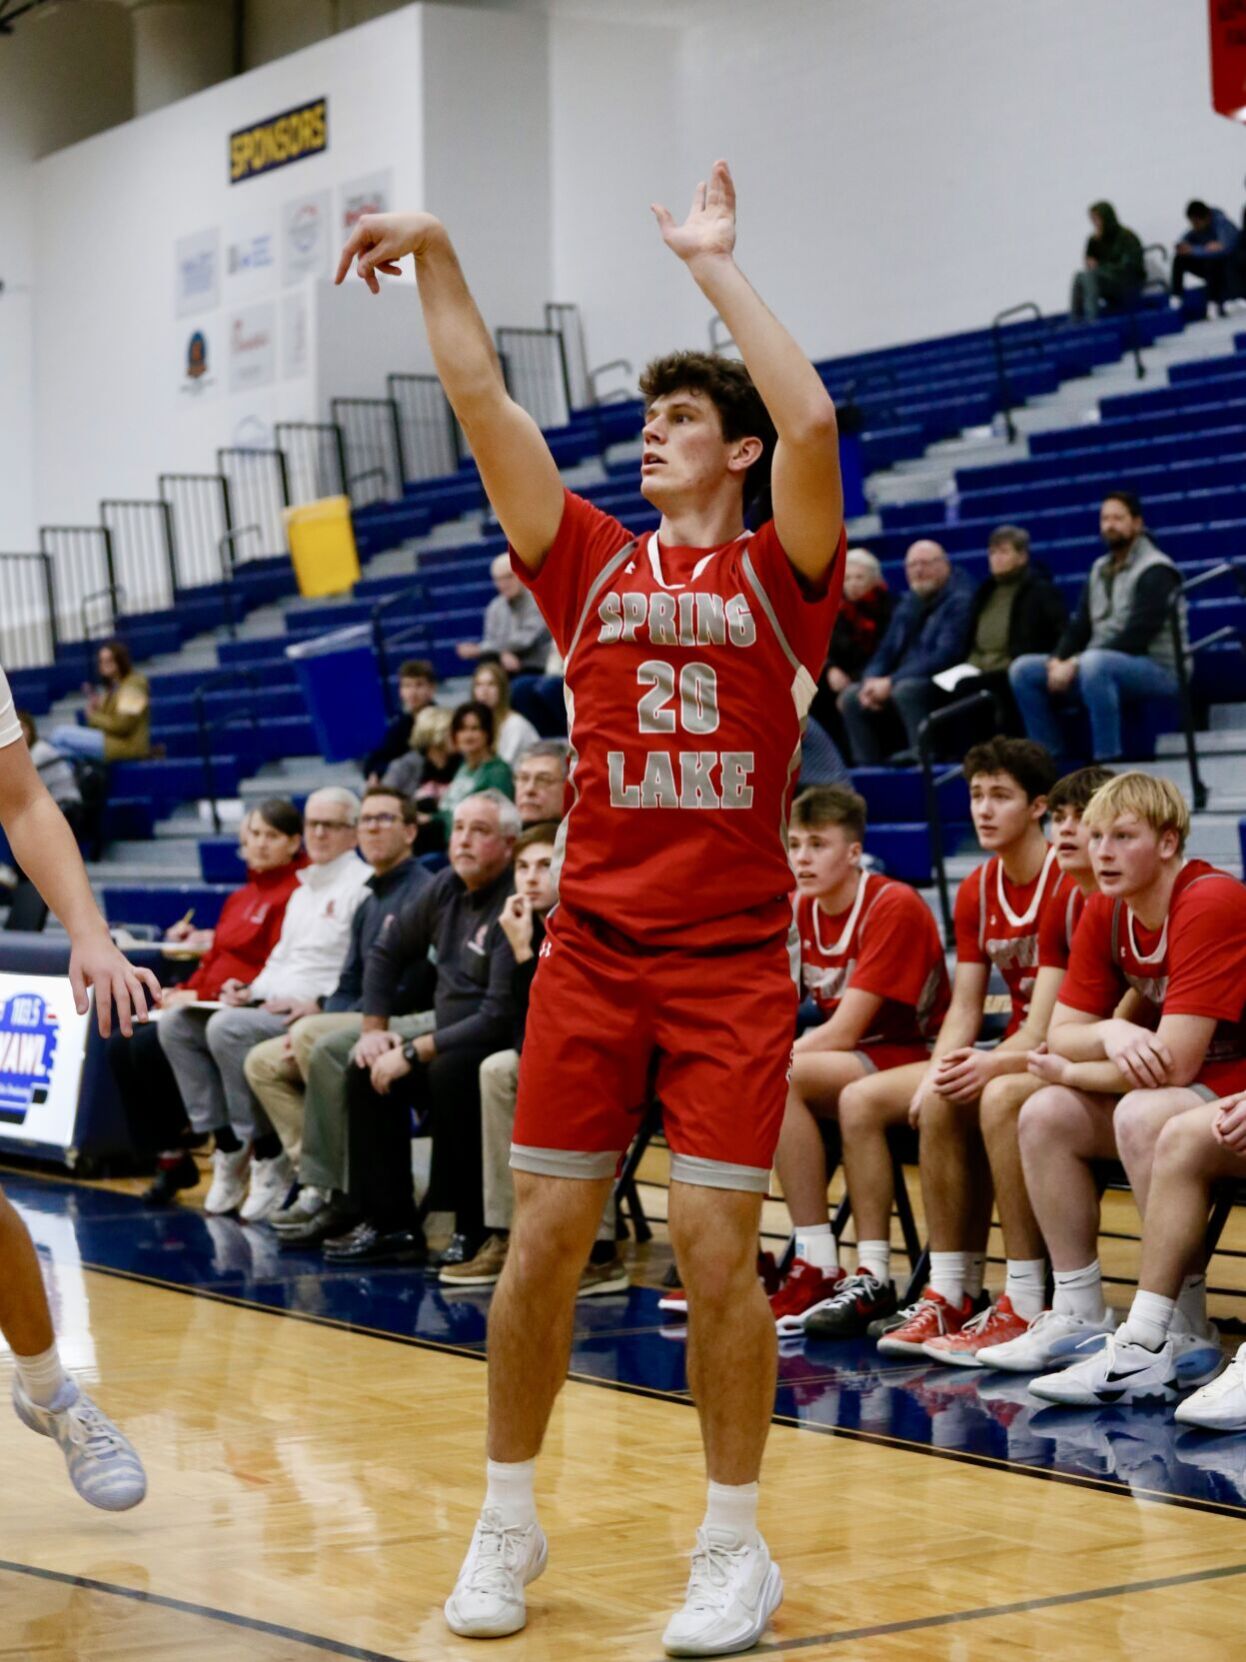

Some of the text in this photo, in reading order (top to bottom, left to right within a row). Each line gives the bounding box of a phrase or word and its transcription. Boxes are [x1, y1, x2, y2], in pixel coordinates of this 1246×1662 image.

[232, 103, 327, 178] SPONSORS
[598, 592, 756, 647] SPRING
[637, 660, 720, 735] 20
[607, 751, 755, 809] LAKE
